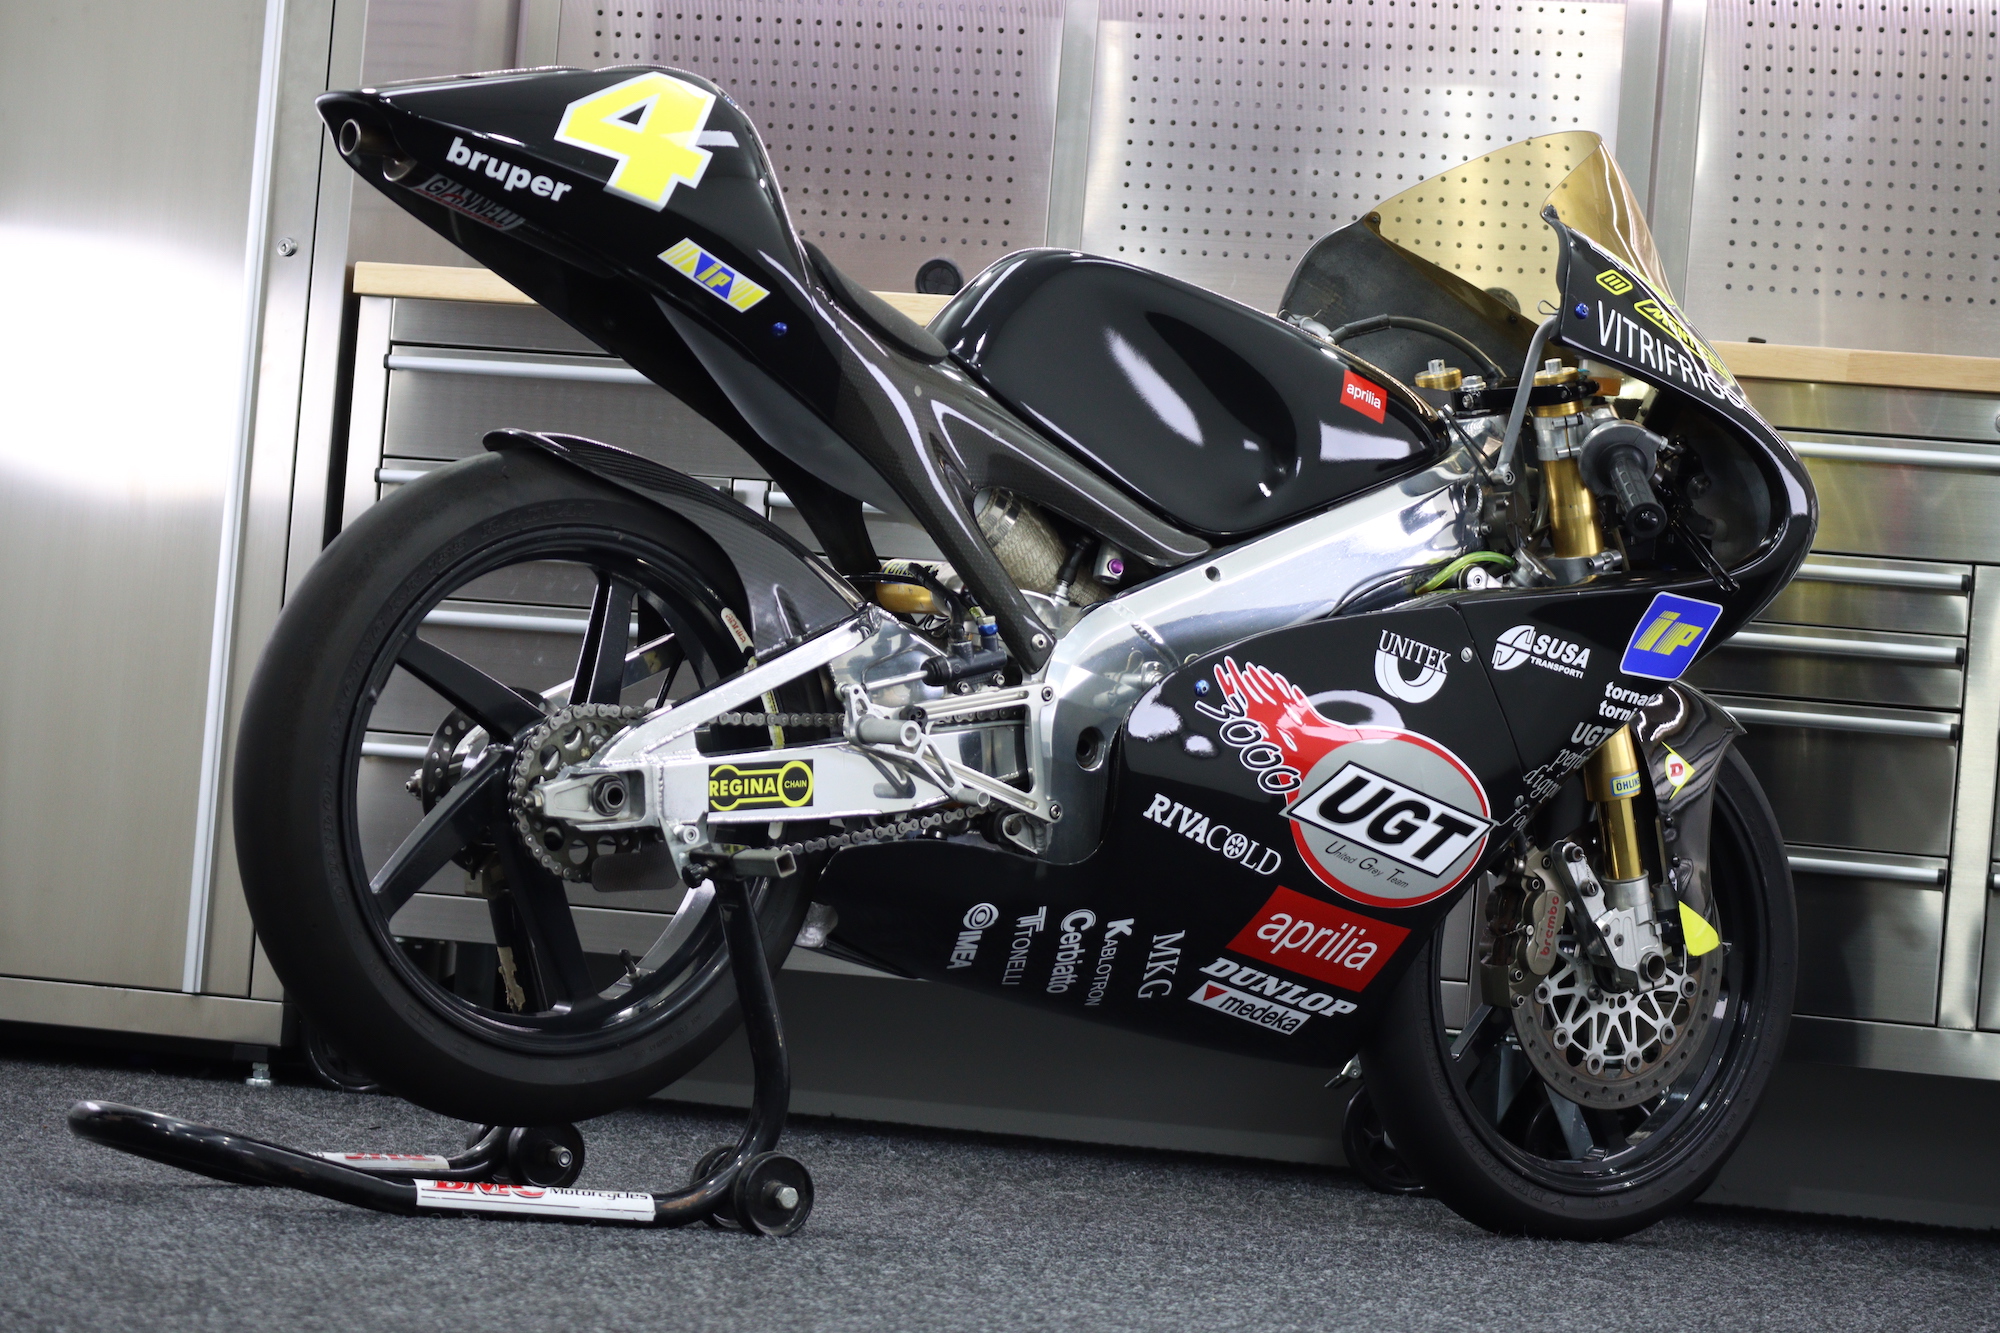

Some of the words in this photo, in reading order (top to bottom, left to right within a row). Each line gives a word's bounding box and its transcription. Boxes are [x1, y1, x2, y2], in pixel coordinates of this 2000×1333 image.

[445, 137, 572, 202] bruper
[554, 71, 716, 212] 4
[1346, 383, 1382, 409] aprilia
[1379, 629, 1452, 675] UNITEK
[1530, 656, 1584, 679] TRANSPORTI
[1532, 634, 1591, 669] SUSA
[709, 777, 776, 797] REGINA
[783, 779, 807, 789] CHAIN
[1143, 793, 1282, 876] RIVACOLD
[1316, 774, 1479, 863] UGT
[1325, 841, 1358, 864] United
[1386, 868, 1409, 888] Team
[1046, 909, 1097, 993] Cerbiatto
[1256, 912, 1378, 971] aprilia
[1539, 895, 1560, 957] brembo
[1002, 927, 1033, 985] TONELLI
[1199, 957, 1359, 1017] DUNLOP
[1218, 993, 1302, 1034] medeka
